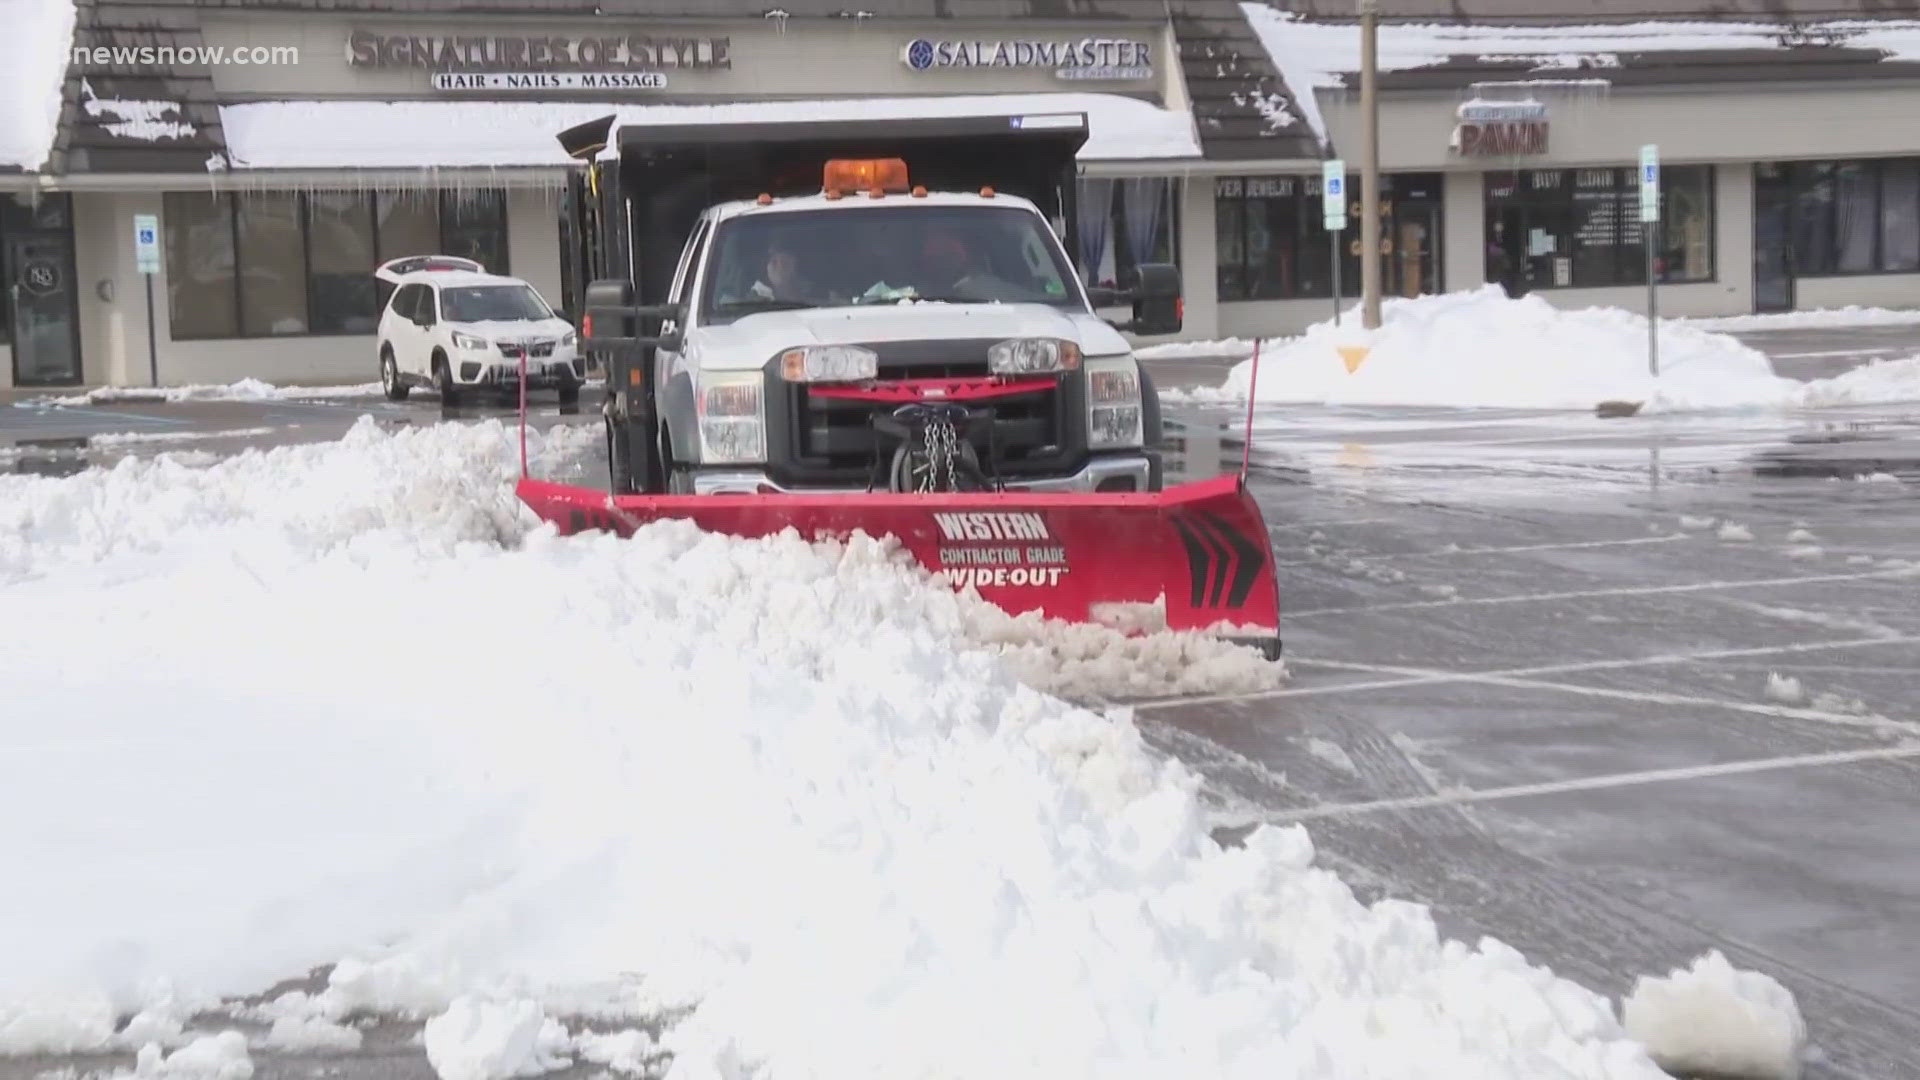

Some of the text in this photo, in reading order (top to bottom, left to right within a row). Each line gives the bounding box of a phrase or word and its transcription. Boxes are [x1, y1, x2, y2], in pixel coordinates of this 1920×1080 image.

[349, 32, 732, 70] SIGNATURES OF STYLE
[936, 40, 1151, 67] SALADMASTER
[439, 73, 663, 88] HAIR NAILS MASSAGE
[1460, 121, 1550, 156] PAWN
[933, 512, 1049, 540] WESTERN
[940, 547, 1066, 565] CONTRACTOR GRADE
